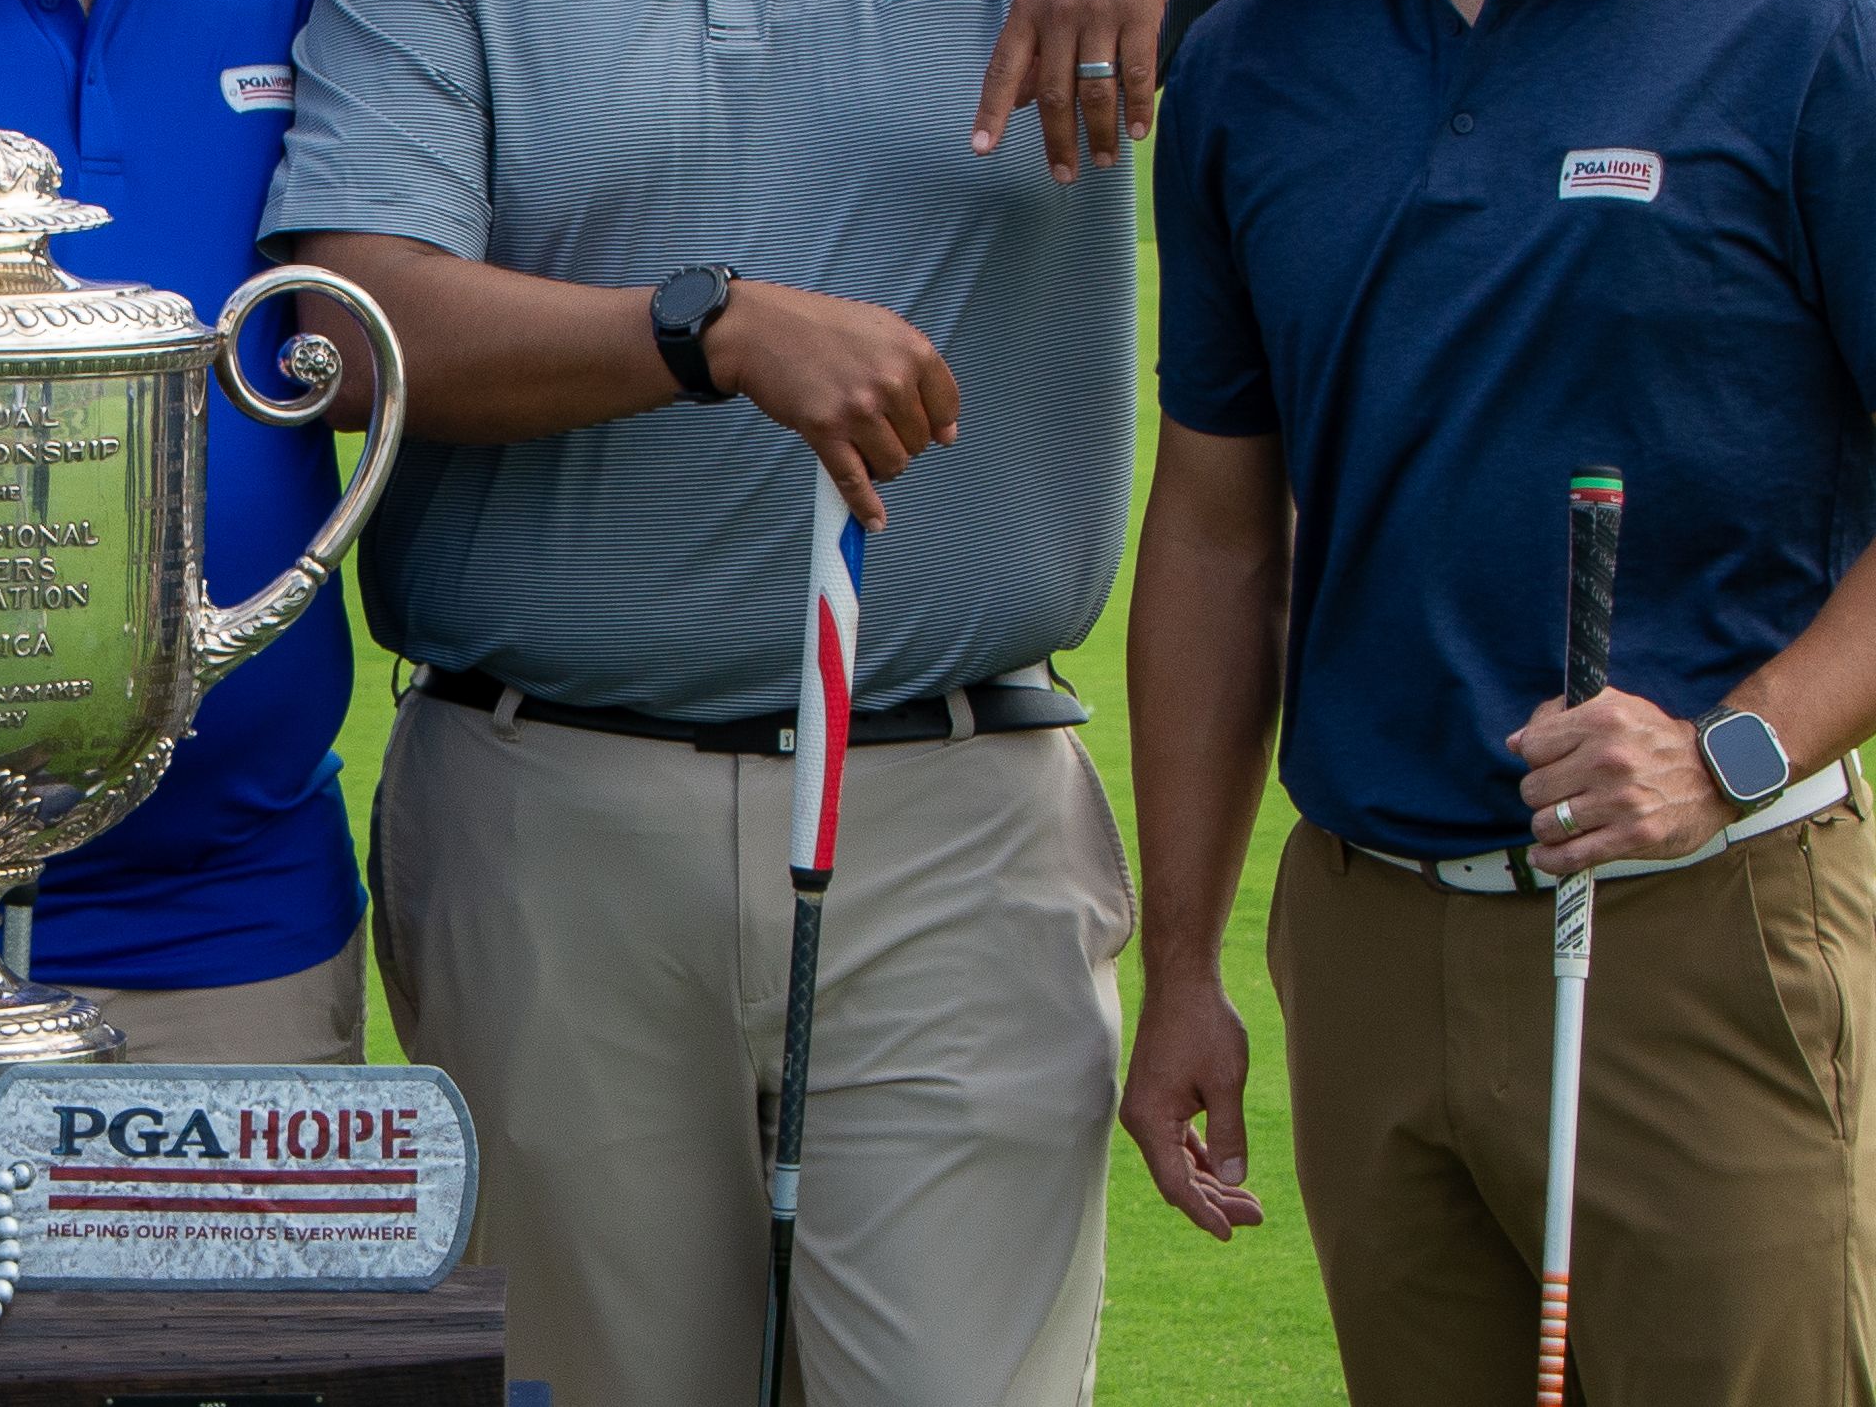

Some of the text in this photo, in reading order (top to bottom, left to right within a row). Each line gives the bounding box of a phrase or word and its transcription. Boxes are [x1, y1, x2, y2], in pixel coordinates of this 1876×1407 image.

[236, 76, 271, 91] PGA
[1573, 160, 1652, 178] PGA HOPE
[50, 1106, 419, 1160] PGA HOPE
[47, 1222, 419, 1242] HELPING OUR PATRIOTS EVERYWHERE
